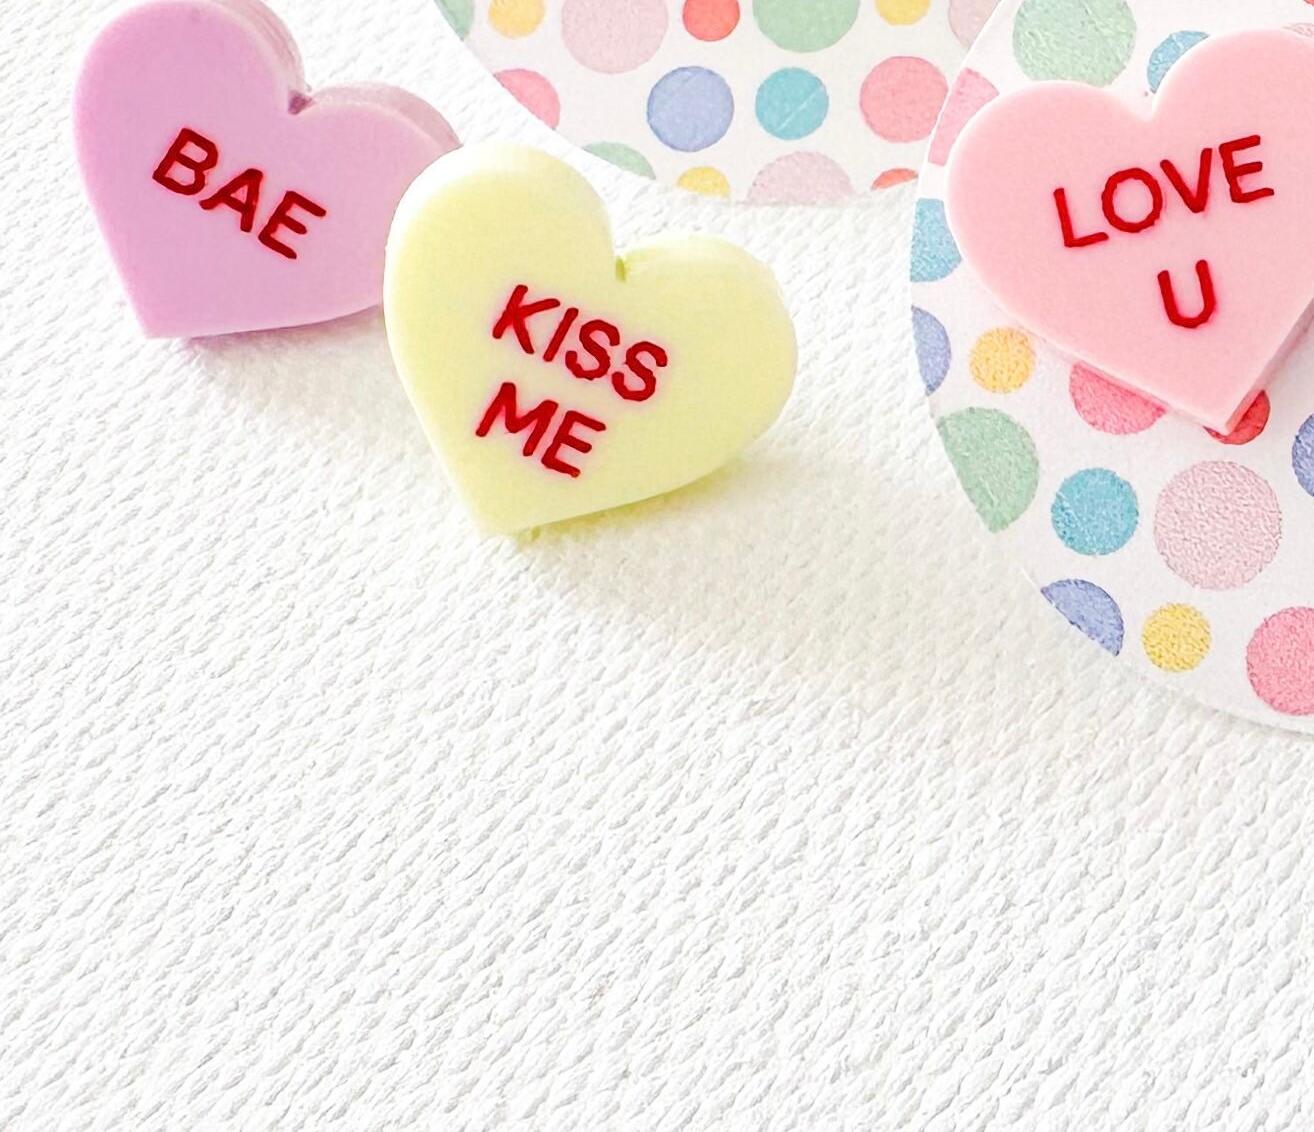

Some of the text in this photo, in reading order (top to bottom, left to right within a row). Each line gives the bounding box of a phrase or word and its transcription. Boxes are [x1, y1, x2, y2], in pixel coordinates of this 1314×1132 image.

[151, 127, 328, 261] BAE
[1052, 134, 1275, 249] LOVE
[491, 284, 669, 403] KISS
[1156, 259, 1219, 330] U
[474, 381, 607, 479] ME
